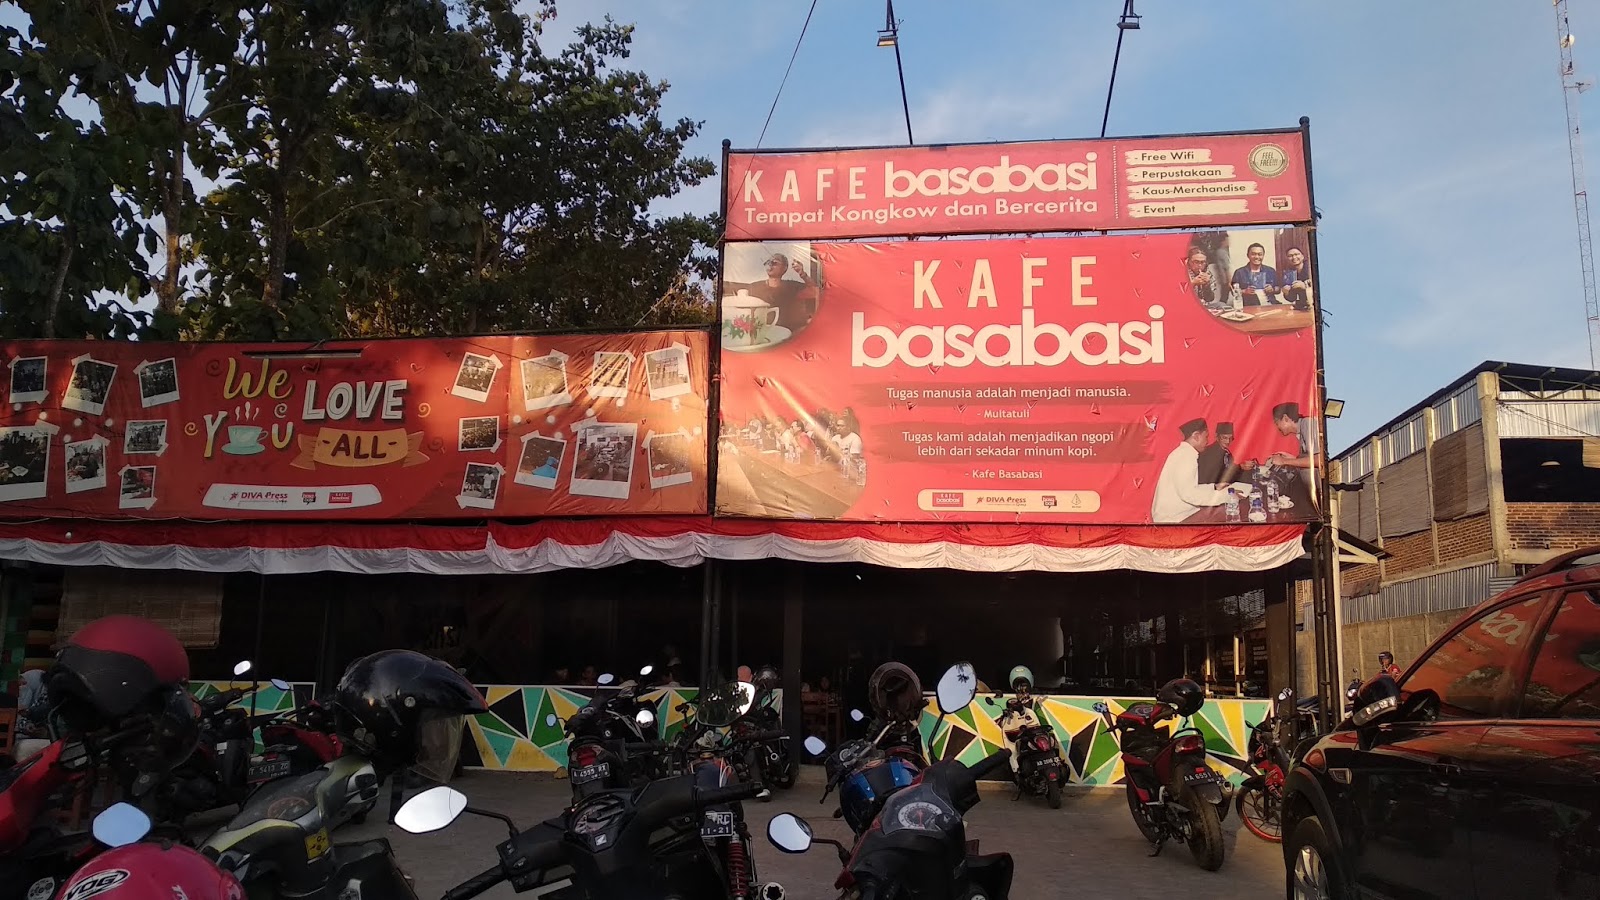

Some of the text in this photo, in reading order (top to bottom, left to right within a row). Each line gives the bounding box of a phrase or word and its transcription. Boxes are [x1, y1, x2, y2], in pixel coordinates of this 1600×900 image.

[1141, 151, 1195, 161] Free Wifi
[1262, 151, 1274, 159] FEEL
[744, 152, 1098, 202] KAFE basabasi
[1142, 168, 1222, 180] Perpustakaan
[1142, 184, 1246, 195] Kaus-Merchandise
[745, 196, 1097, 227] Tempat Kongkow dan Bercerita
[1144, 204, 1176, 214] Event
[913, 255, 1098, 309] KAFE
[852, 304, 1165, 368] basabasi
[223, 357, 293, 399] We
[301, 379, 408, 420] LOVE
[887, 386, 1131, 400] Tugas manusia adalah menjadi manusia.
[984, 409, 1030, 419] Multatuli
[902, 431, 1114, 444] Tugas kami adalah menjadikan ngopi
[331, 433, 387, 460] ALL
[917, 445, 1097, 458] lebih dari sekadar minum kopi.
[972, 469, 1043, 479] Kafe Basabasi
[265, 491, 288, 499] Press
